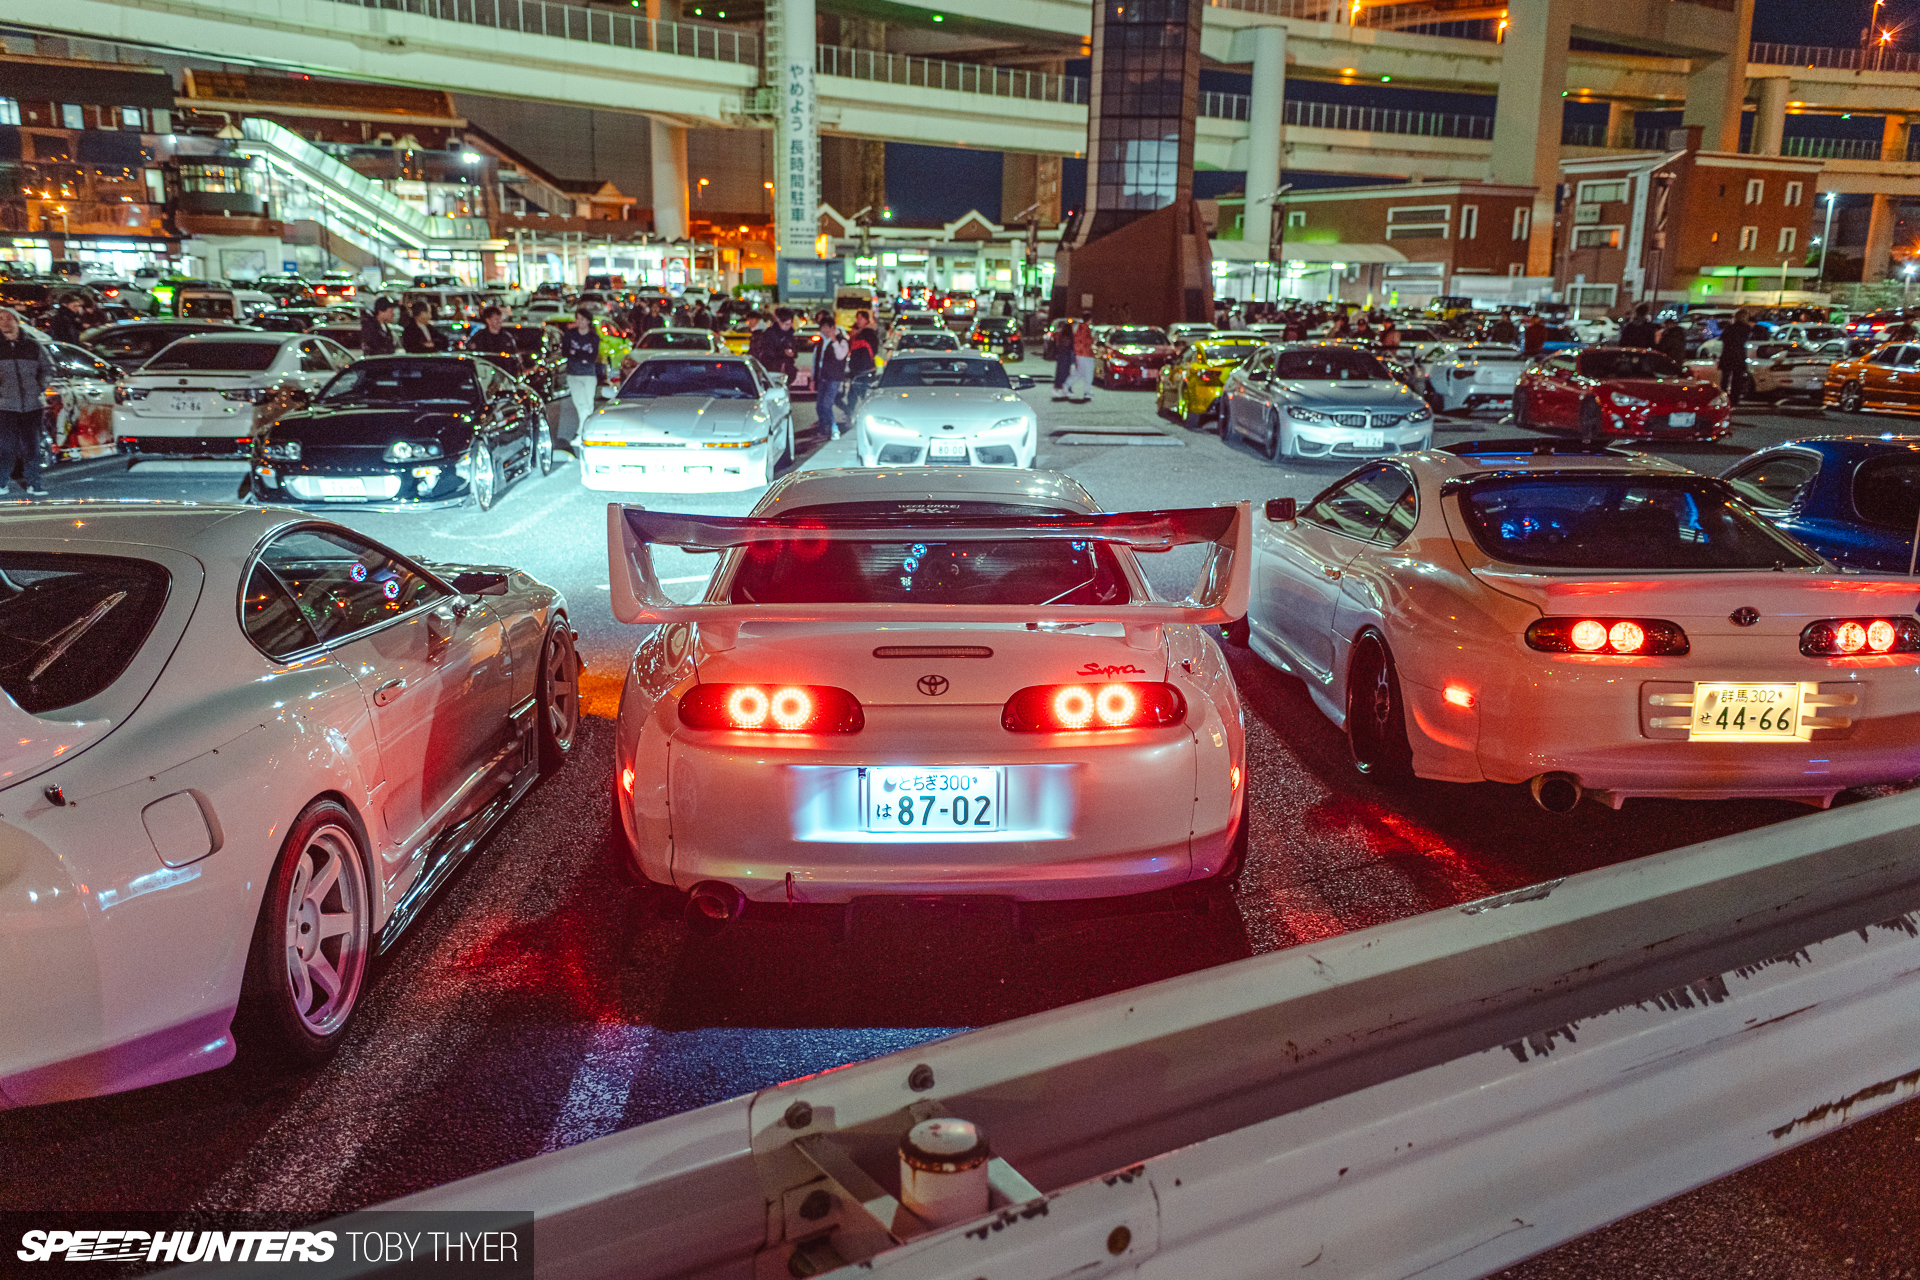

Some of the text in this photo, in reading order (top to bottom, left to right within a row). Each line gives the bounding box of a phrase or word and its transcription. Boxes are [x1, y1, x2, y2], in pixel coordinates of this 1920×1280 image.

[790, 64, 804, 132] やめよう
[790, 139, 805, 222] 長時間駐車
[1077, 662, 1145, 679] Supra
[1700, 706, 1791, 731] せ 44-66
[876, 796, 991, 826] は 87-02
